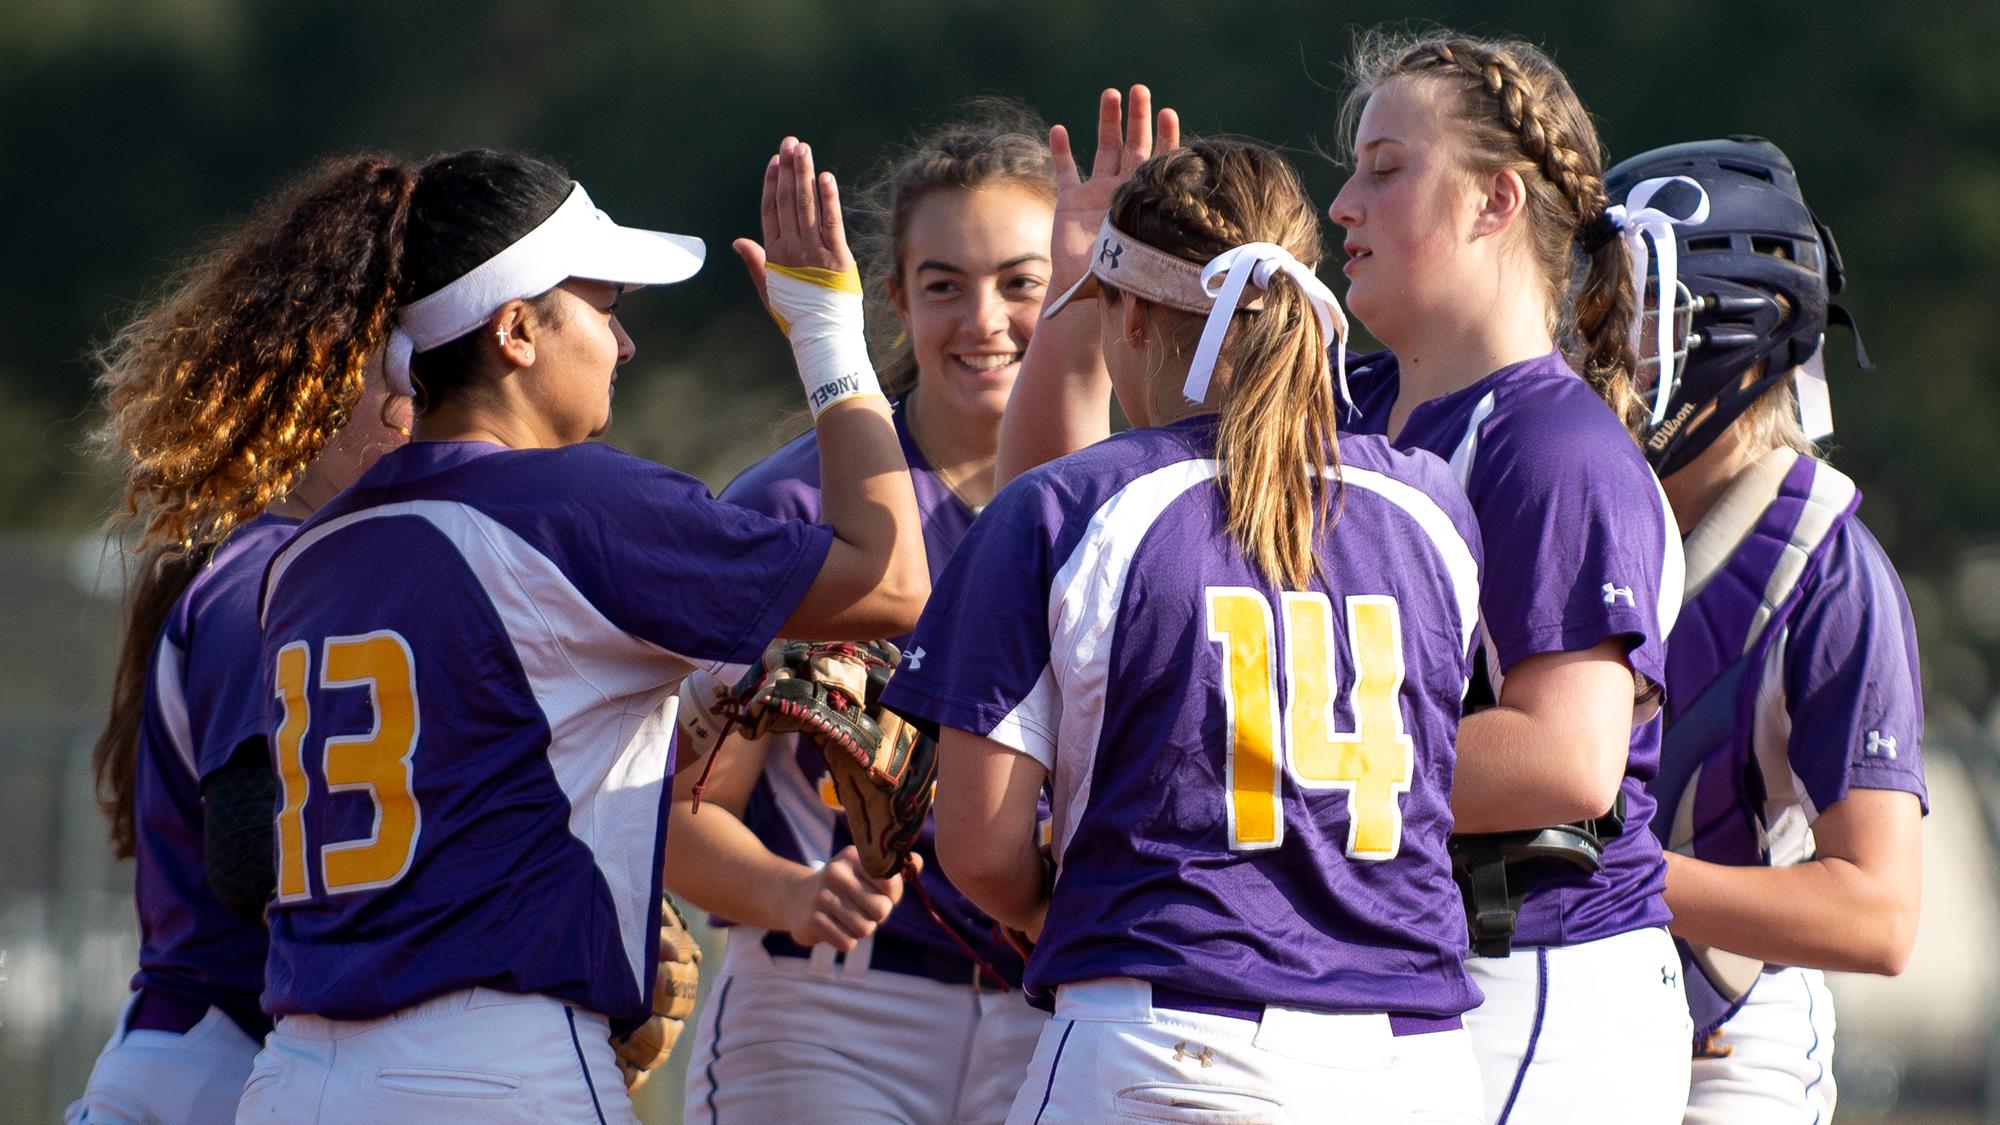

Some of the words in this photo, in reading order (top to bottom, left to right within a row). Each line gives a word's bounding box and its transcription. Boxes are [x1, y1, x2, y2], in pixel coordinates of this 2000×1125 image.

[810, 372, 859, 408] ANGEL
[1648, 402, 1696, 450] Wilson
[275, 629, 421, 903] 13
[1205, 586, 1414, 861] 14
